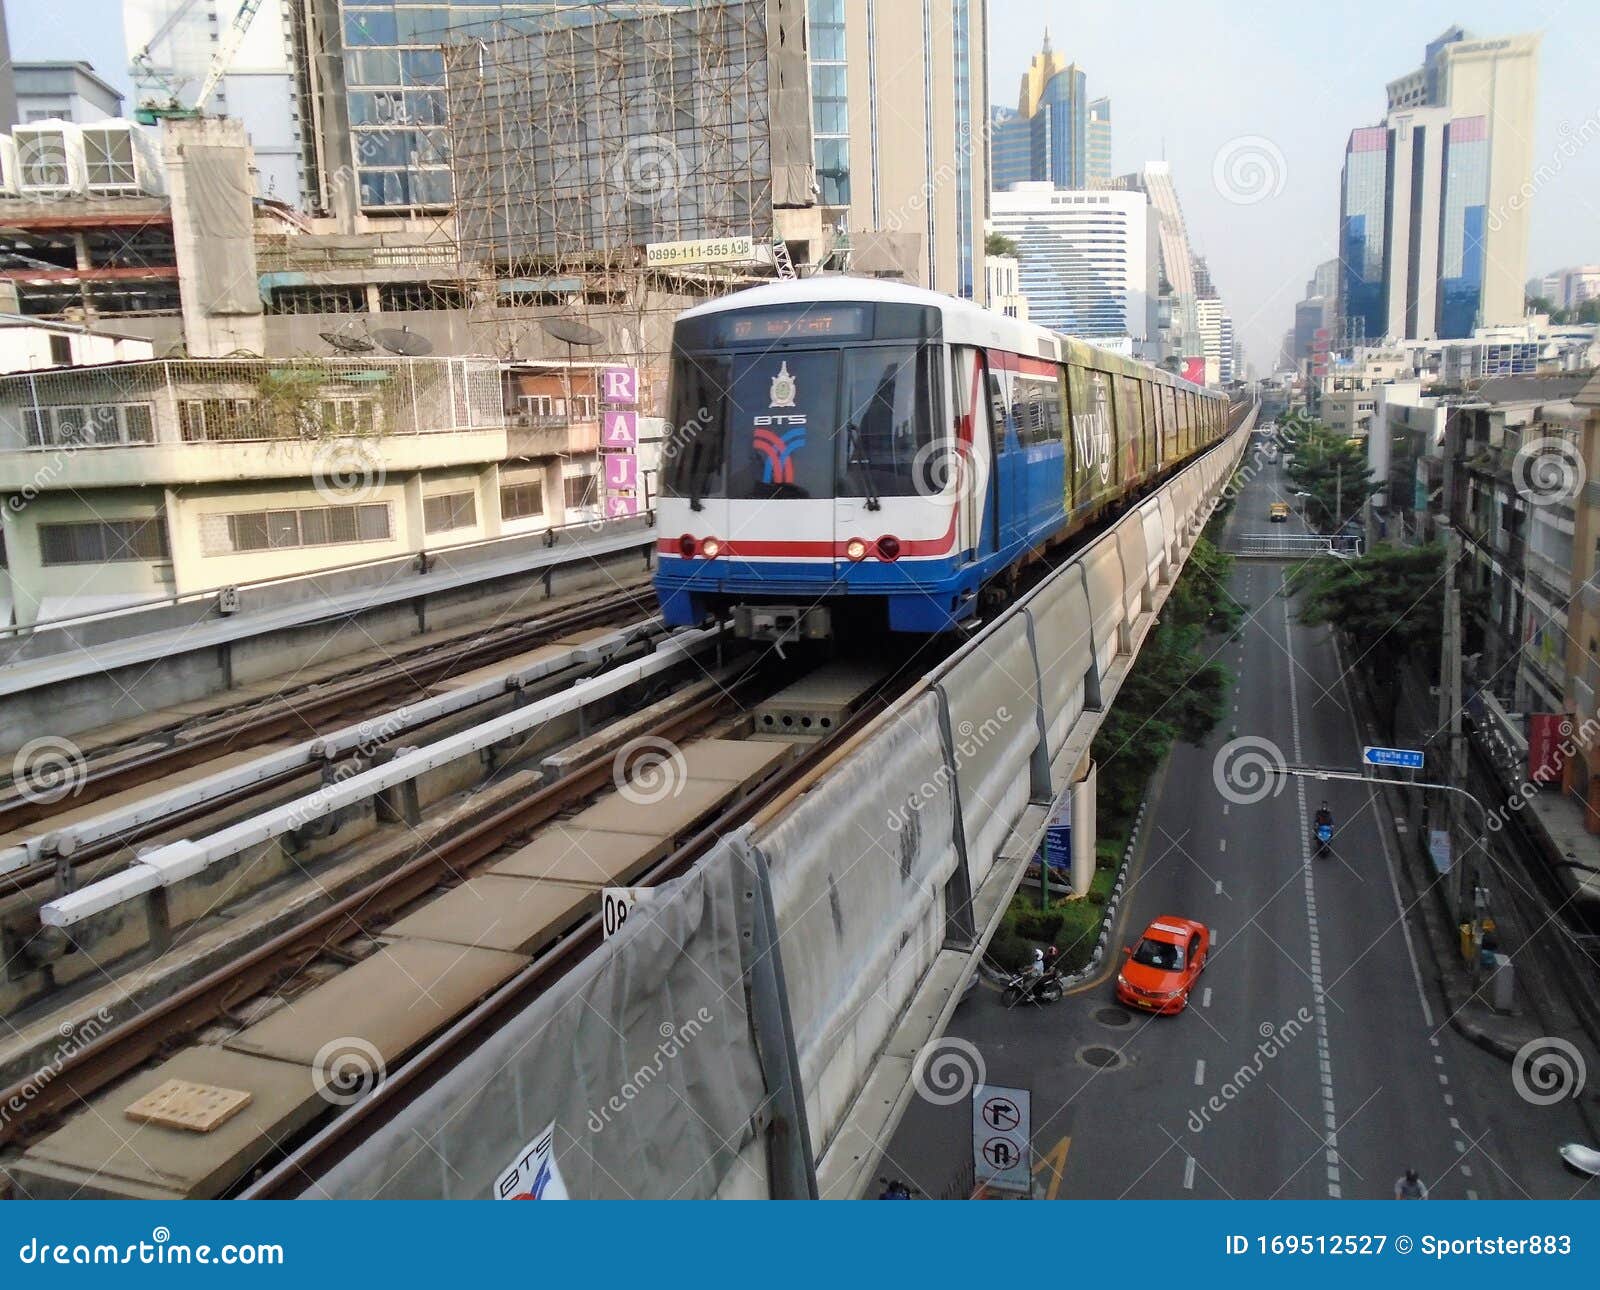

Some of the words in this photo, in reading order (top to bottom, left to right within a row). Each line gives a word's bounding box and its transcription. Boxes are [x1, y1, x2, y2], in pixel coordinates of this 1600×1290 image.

[649, 240, 728, 260] 0899-111-555
[753, 414, 807, 425] BTS
[607, 372, 633, 518] RAJA
[605, 894, 633, 934] 08
[500, 1131, 552, 1198] BTS
